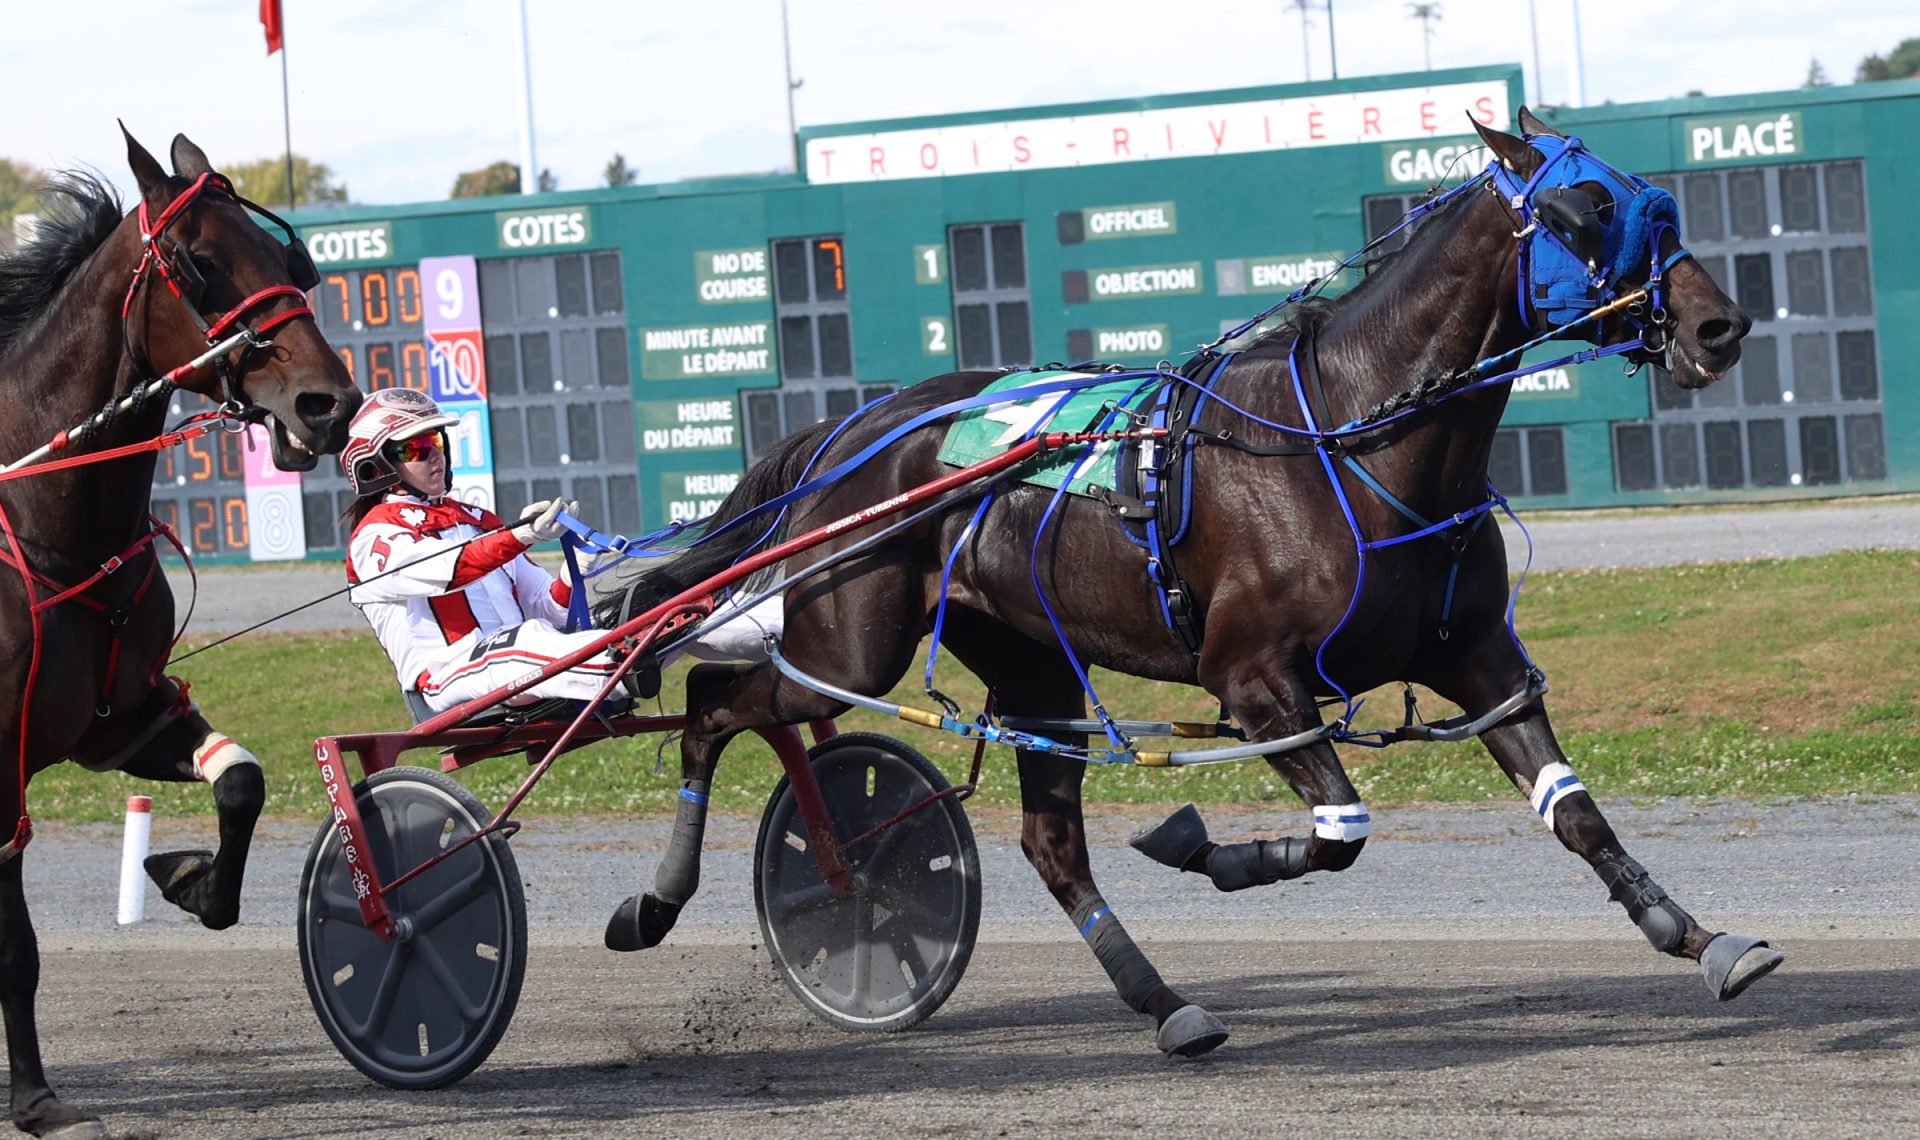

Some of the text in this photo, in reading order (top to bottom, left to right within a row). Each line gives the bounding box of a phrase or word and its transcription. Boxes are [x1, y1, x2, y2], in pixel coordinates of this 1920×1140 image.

[1692, 113, 1796, 160] PLACÉ
[503, 212, 586, 247] COTES
[1090, 208, 1169, 233] OFFICIEL
[308, 228, 388, 263] COTES
[712, 251, 765, 274] NO DE
[819, 242, 844, 291] 7
[923, 249, 938, 279] 1
[436, 268, 463, 319] 9
[701, 276, 767, 300] COURSE
[1095, 268, 1196, 295] OBJECTION
[646, 324, 766, 351] MINUTE AVANT
[928, 321, 947, 351] 2
[1099, 329, 1163, 353] PHOTO
[431, 338, 480, 396] 10
[682, 348, 768, 374] LE DÉPART
[677, 400, 733, 422] HEURE
[643, 424, 734, 450] DU DÉPART
[260, 492, 291, 549] 8
[669, 499, 723, 520] DU JO
[826, 492, 910, 534] JESSICA TURENNE
